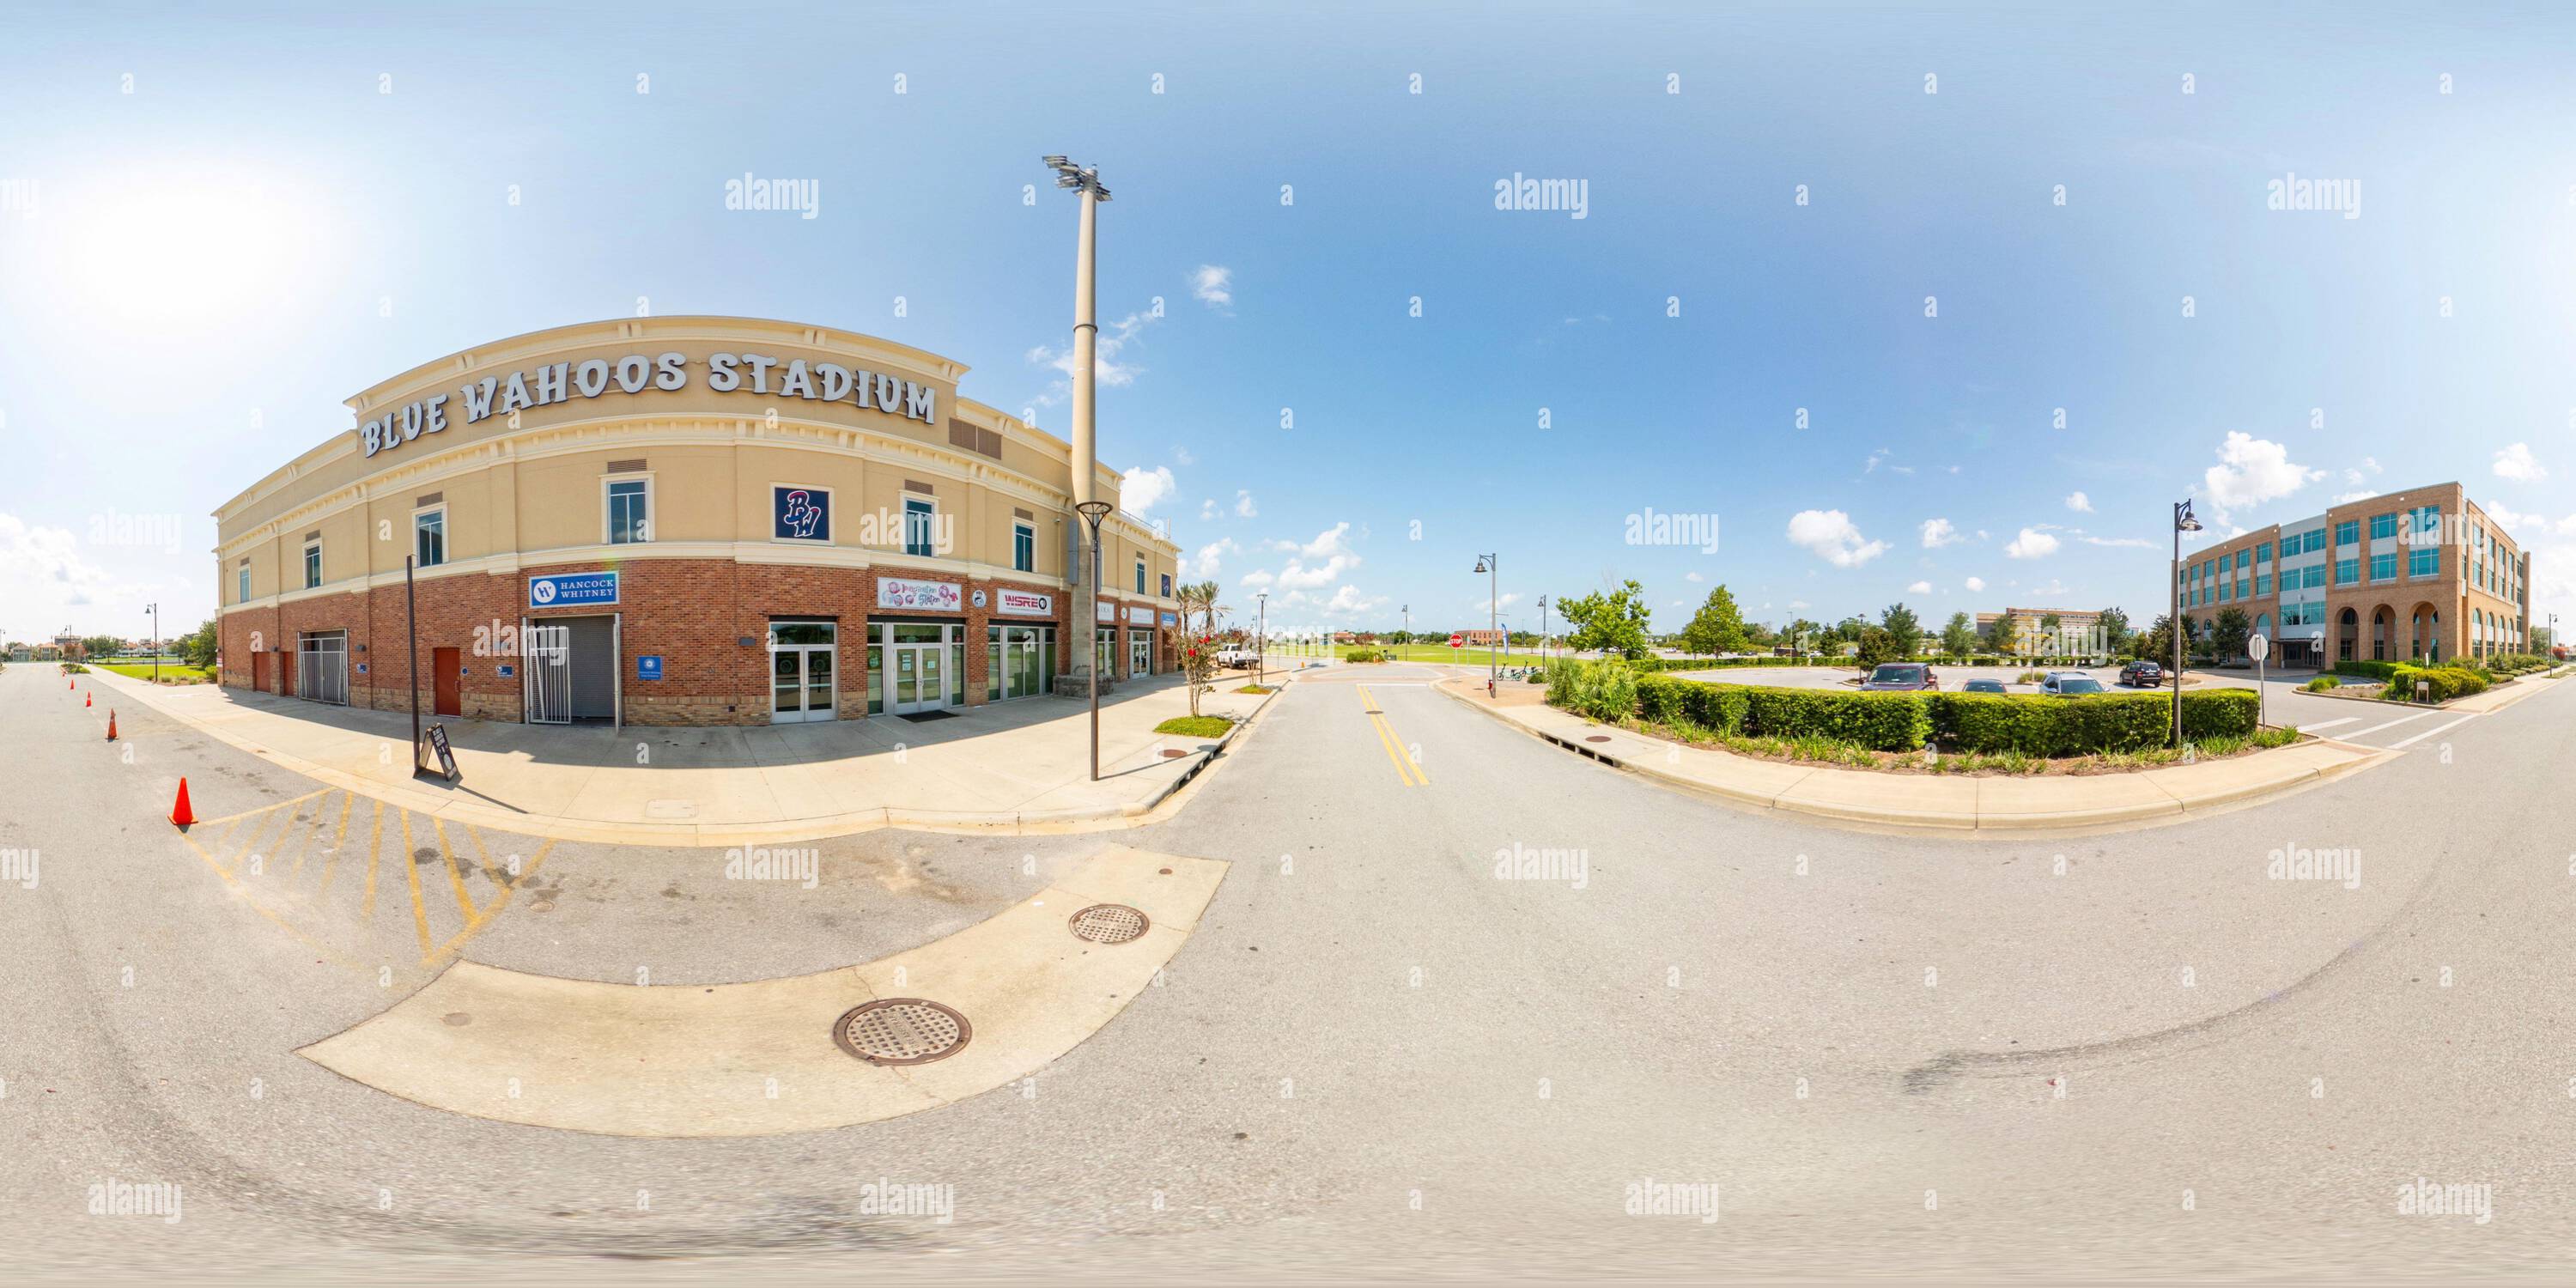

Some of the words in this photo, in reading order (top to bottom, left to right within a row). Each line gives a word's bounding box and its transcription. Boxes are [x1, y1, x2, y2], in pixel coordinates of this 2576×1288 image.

[361, 393, 448, 459] BLUE
[460, 352, 687, 424] WAHOOS
[708, 352, 937, 425] STADIUM
[561, 580, 614, 590] HANCOCK
[561, 589, 614, 598] WHITNEY
[1005, 594, 1039, 608] WSRE
